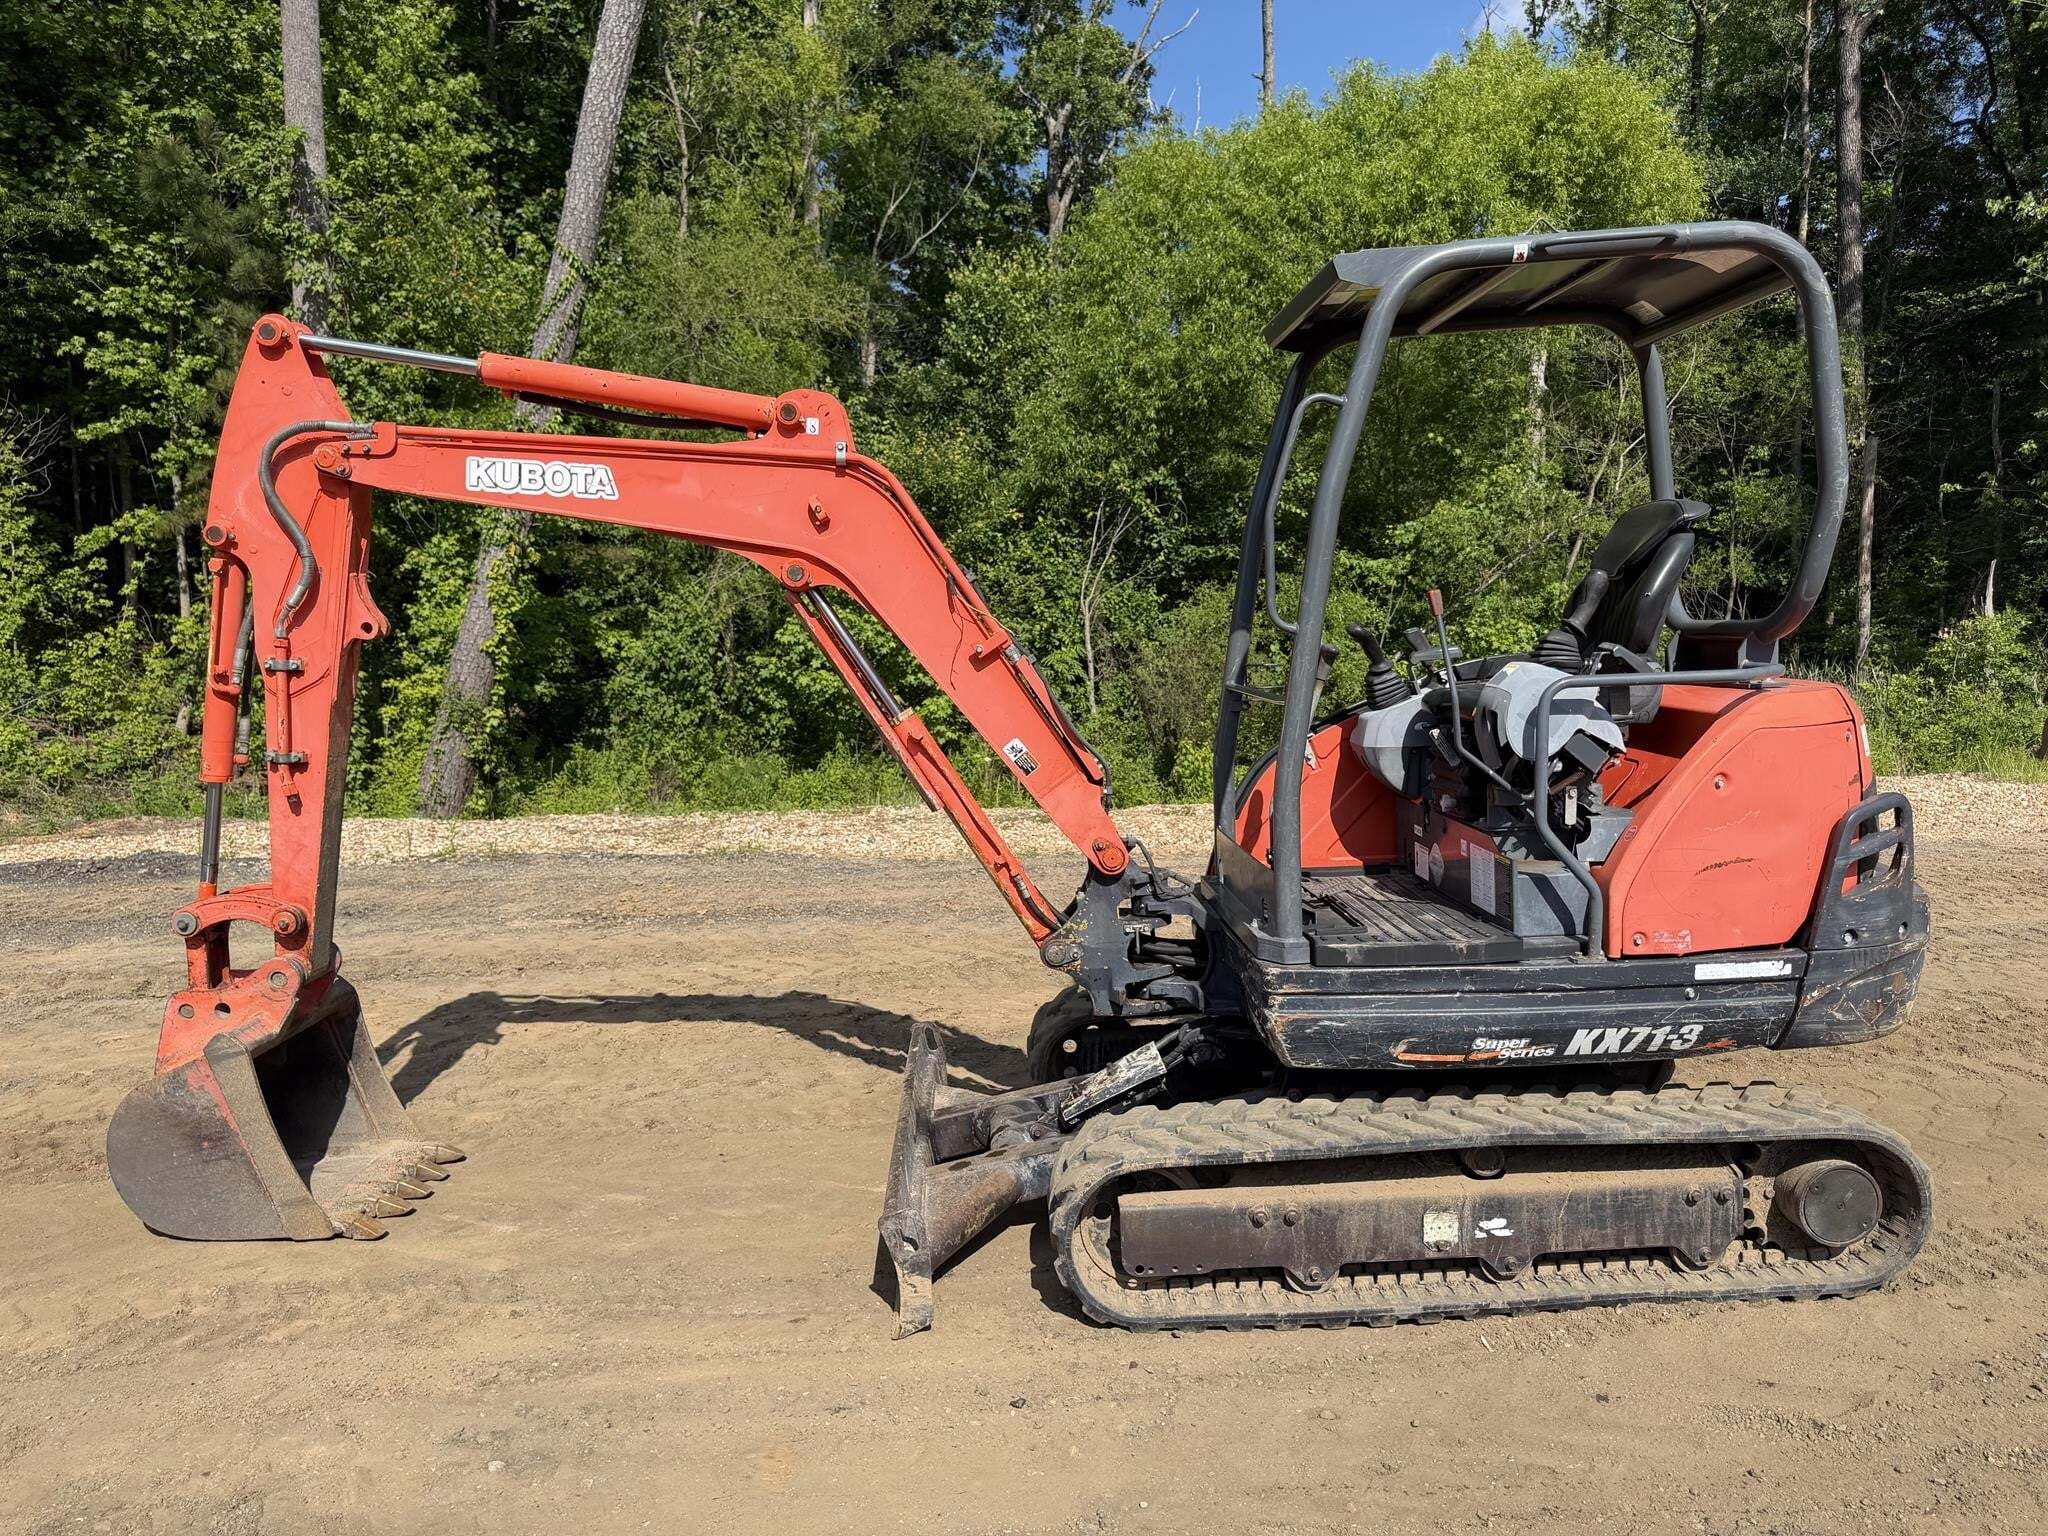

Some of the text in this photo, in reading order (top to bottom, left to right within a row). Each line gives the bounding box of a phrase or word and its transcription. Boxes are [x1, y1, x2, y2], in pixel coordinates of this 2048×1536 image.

[467, 457, 617, 498] KUBOTA
[1471, 1037, 1532, 1052] Super
[1498, 1044, 1558, 1059] Series
[1563, 1024, 1704, 1056] KX71-3
